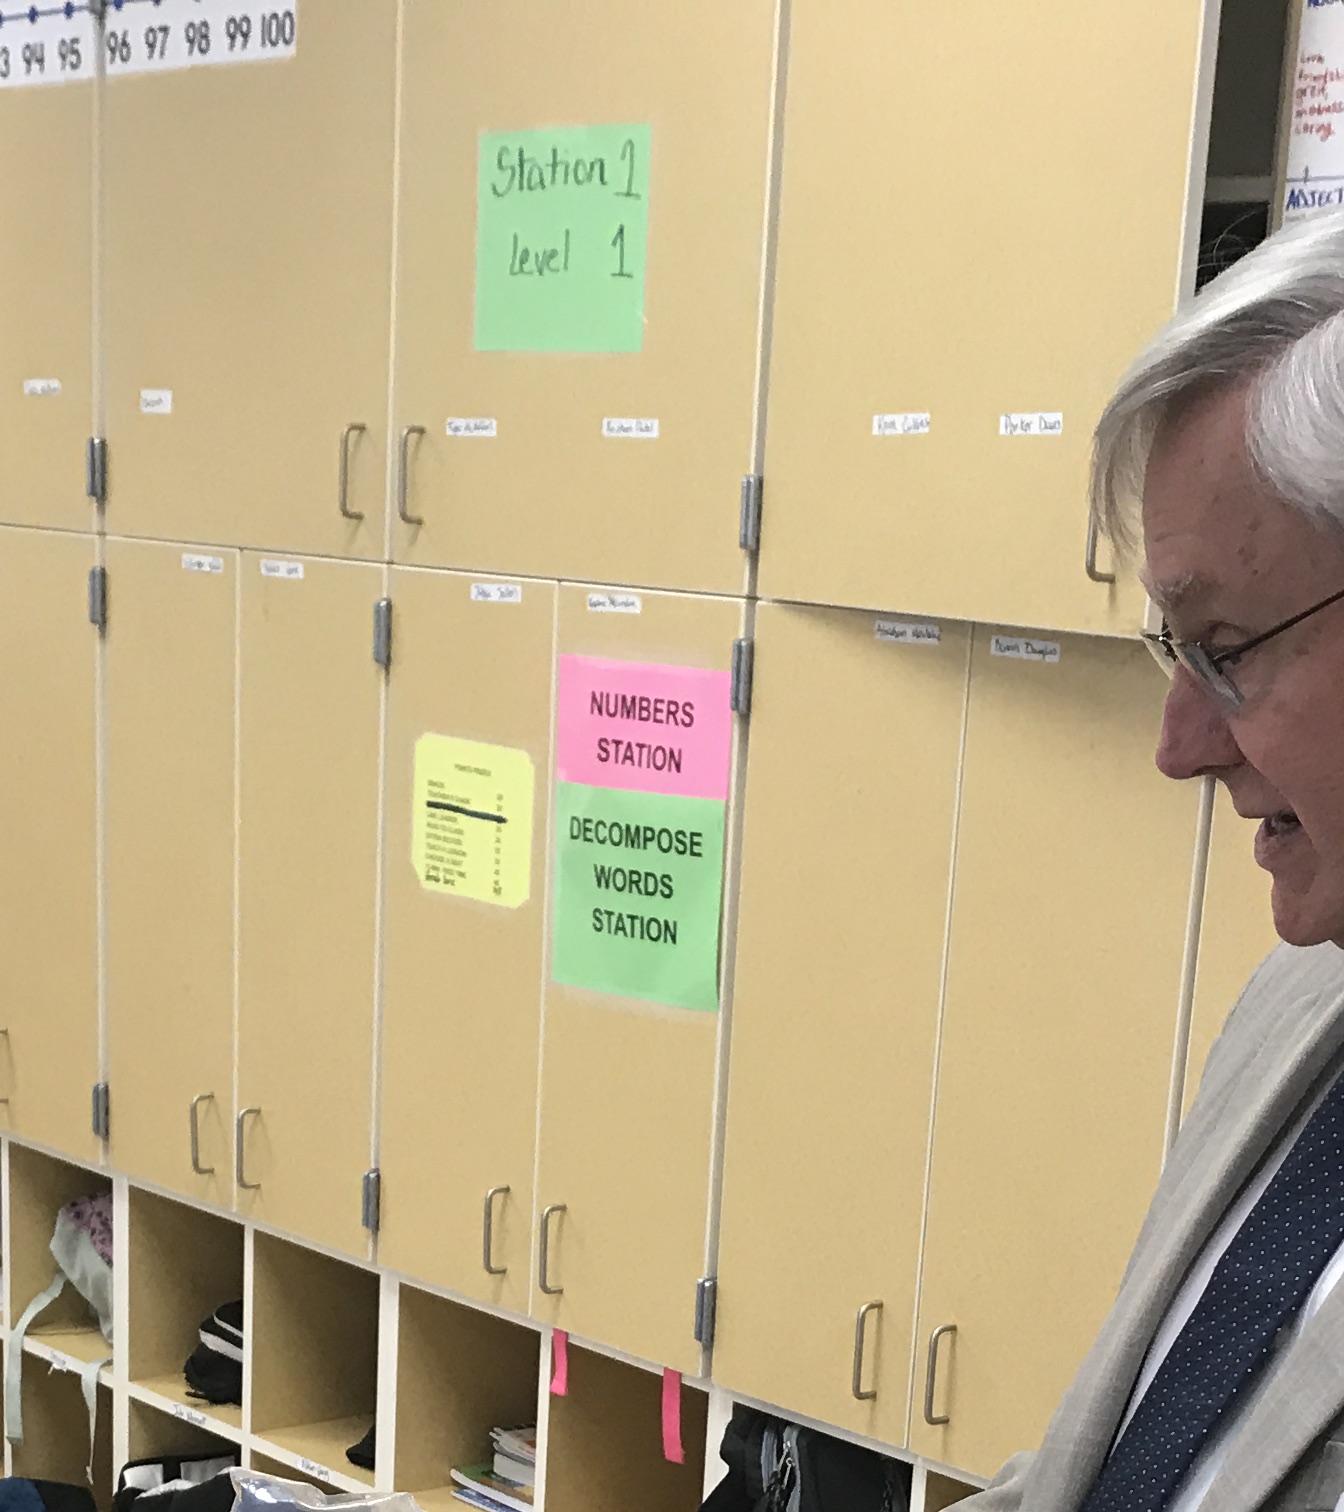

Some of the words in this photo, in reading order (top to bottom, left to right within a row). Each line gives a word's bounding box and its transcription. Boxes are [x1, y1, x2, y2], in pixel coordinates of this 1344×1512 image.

[22, 41, 45, 75] 94
[58, 36, 82, 71] 95
[107, 30, 131, 64] 96
[144, 24, 170, 60] 97
[185, 19, 210, 55] 98
[225, 15, 252, 51] 99
[260, 9, 295, 48] 100
[491, 145, 608, 197] Station
[614, 139, 642, 200] 1
[610, 223, 634, 278] 1
[590, 691, 694, 728] NUMBERS
[597, 737, 682, 773] STATION
[569, 816, 703, 857] DECOMPOSE
[594, 864, 674, 899] WORDS
[592, 907, 677, 945] STATION
